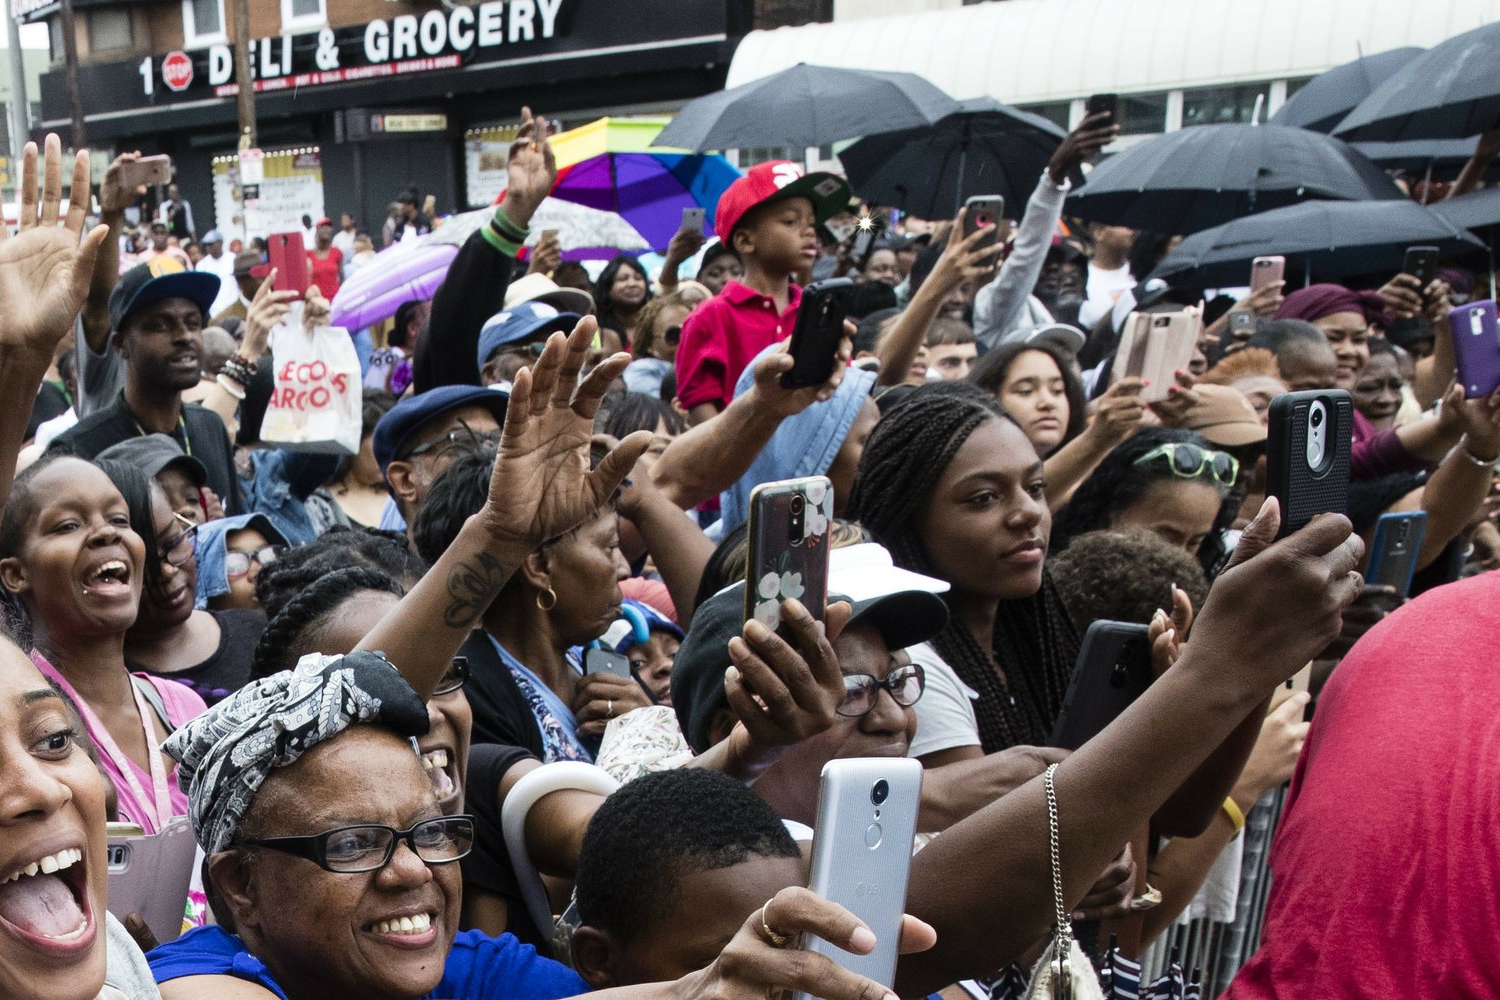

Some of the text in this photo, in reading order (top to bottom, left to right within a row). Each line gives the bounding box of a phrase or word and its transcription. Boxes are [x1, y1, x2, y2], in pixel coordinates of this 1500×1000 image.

[138, 56, 154, 95] 1
[315, 29, 339, 71] &
[364, 0, 564, 64] GROCERY
